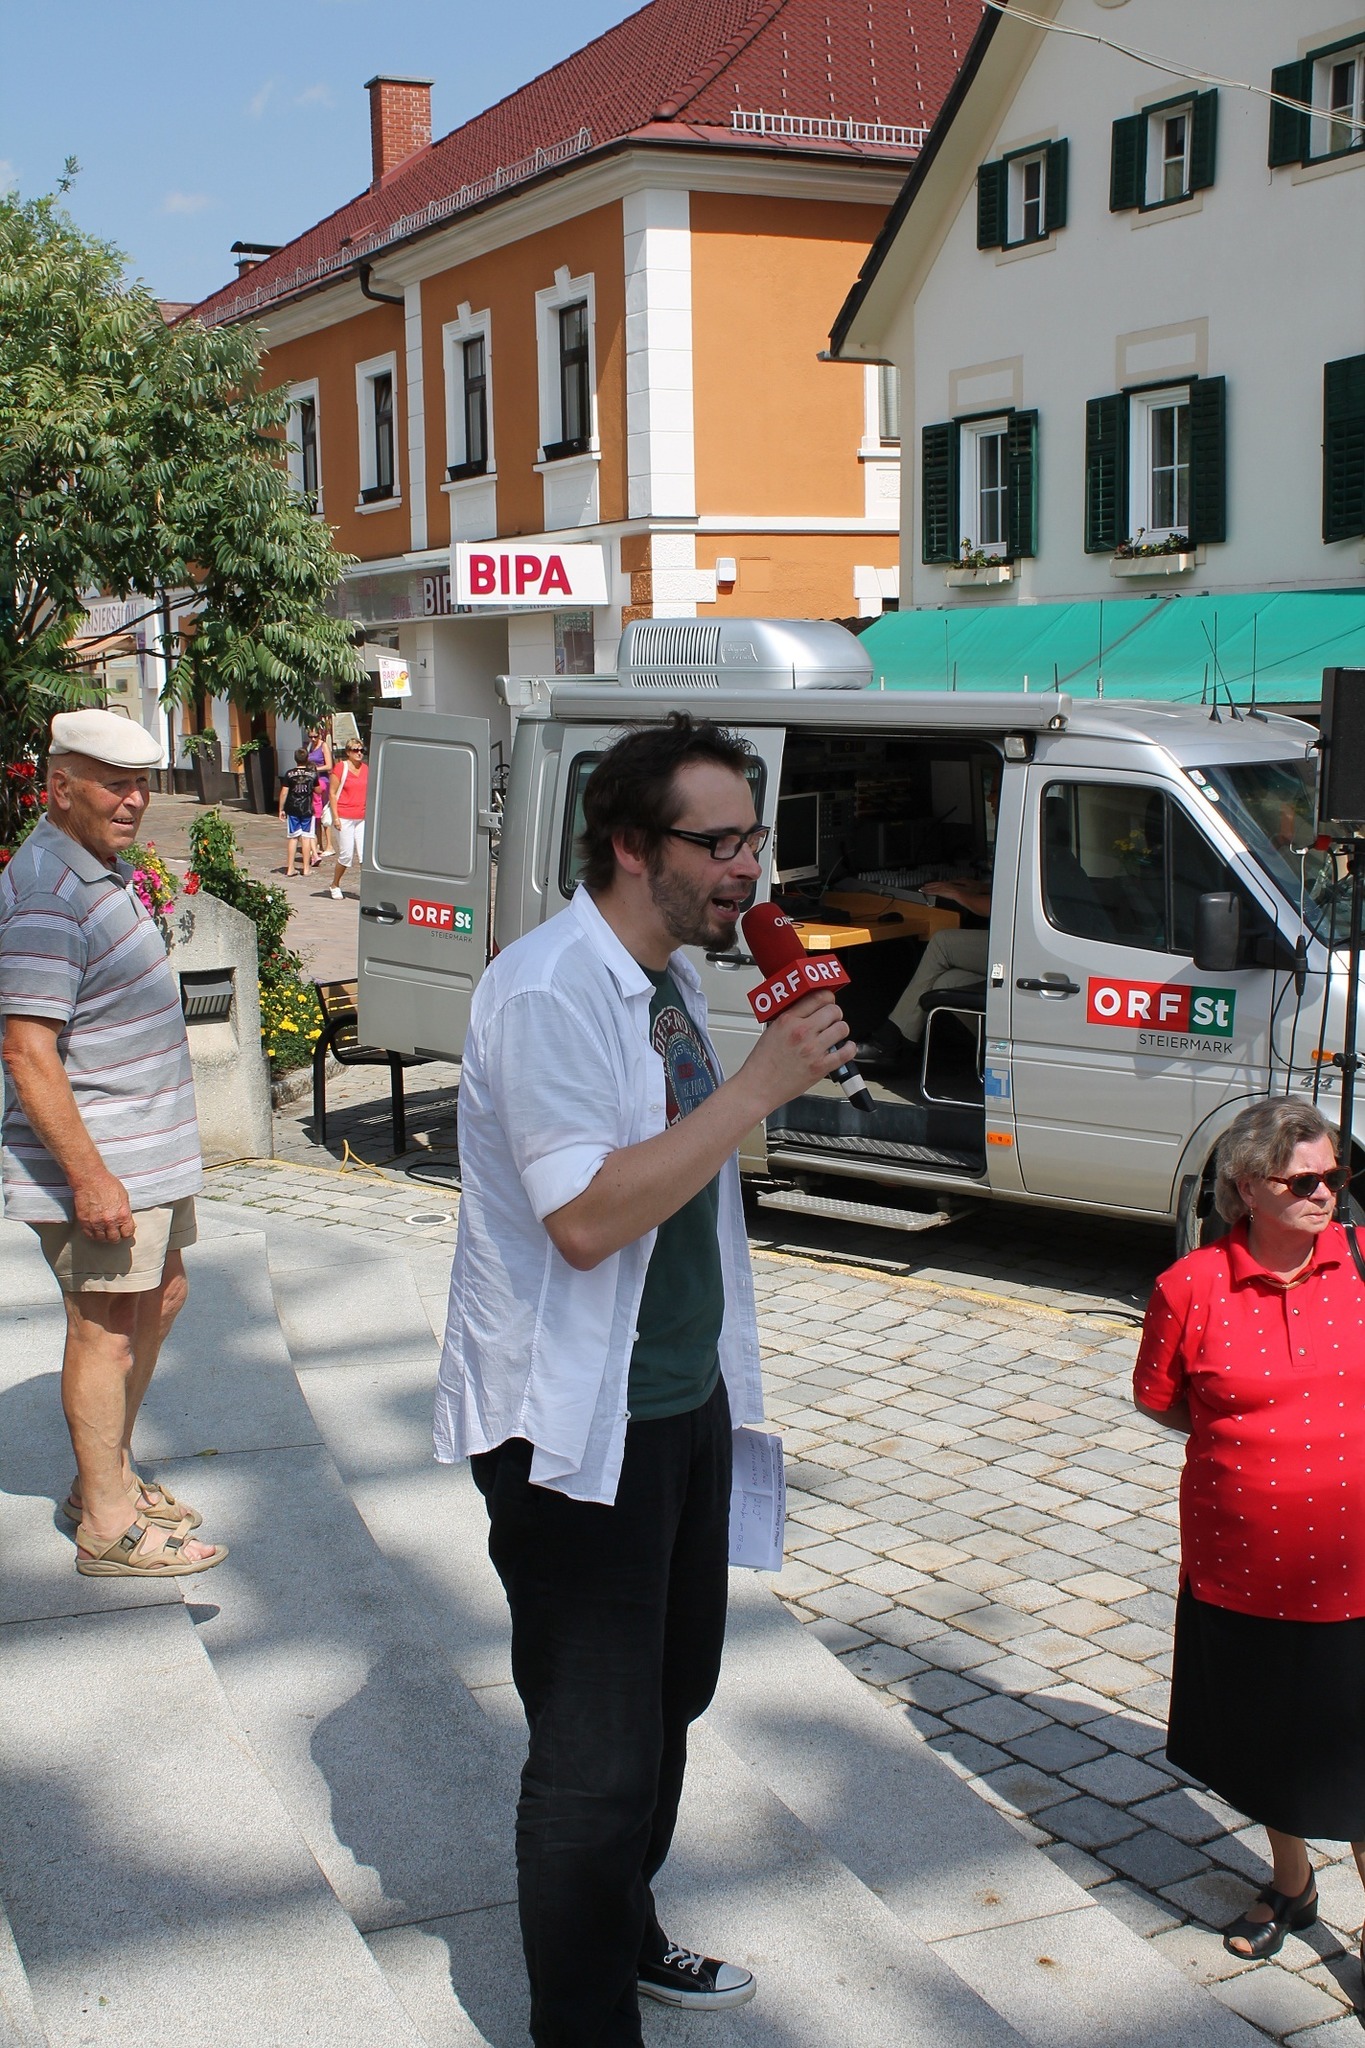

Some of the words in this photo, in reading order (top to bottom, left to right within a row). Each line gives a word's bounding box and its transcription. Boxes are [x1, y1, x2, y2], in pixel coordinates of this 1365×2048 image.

[469, 554, 573, 595] BIPA
[423, 574, 472, 616] BIP
[382, 671, 399, 680] BABY
[383, 680, 395, 689] DAY
[411, 904, 451, 925] ORF
[454, 911, 472, 929] St
[430, 930, 473, 943] STEIERMARK
[804, 961, 842, 982] ORF
[755, 969, 801, 1013] ORF
[1093, 986, 1182, 1021] ORF
[1192, 996, 1230, 1028] St
[1138, 1033, 1233, 1054] STEIERMARK
